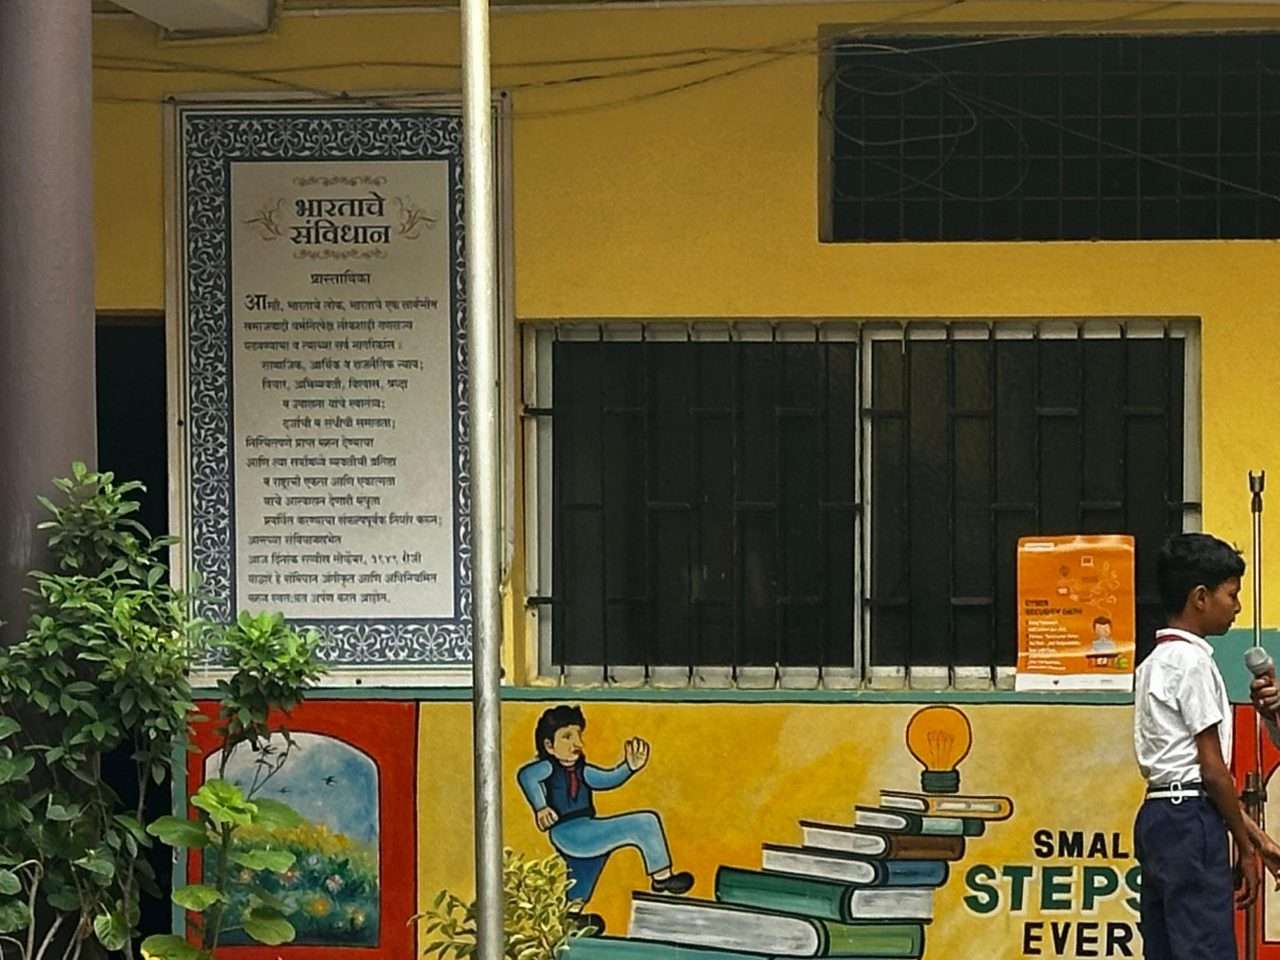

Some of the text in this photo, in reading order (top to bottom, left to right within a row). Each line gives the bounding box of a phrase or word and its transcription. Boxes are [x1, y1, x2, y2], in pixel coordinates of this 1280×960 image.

[296, 191, 385, 218] भारताचे
[289, 220, 390, 245] संविधान
[963, 864, 1142, 914] STEPS
[1023, 922, 1141, 956] EVER
